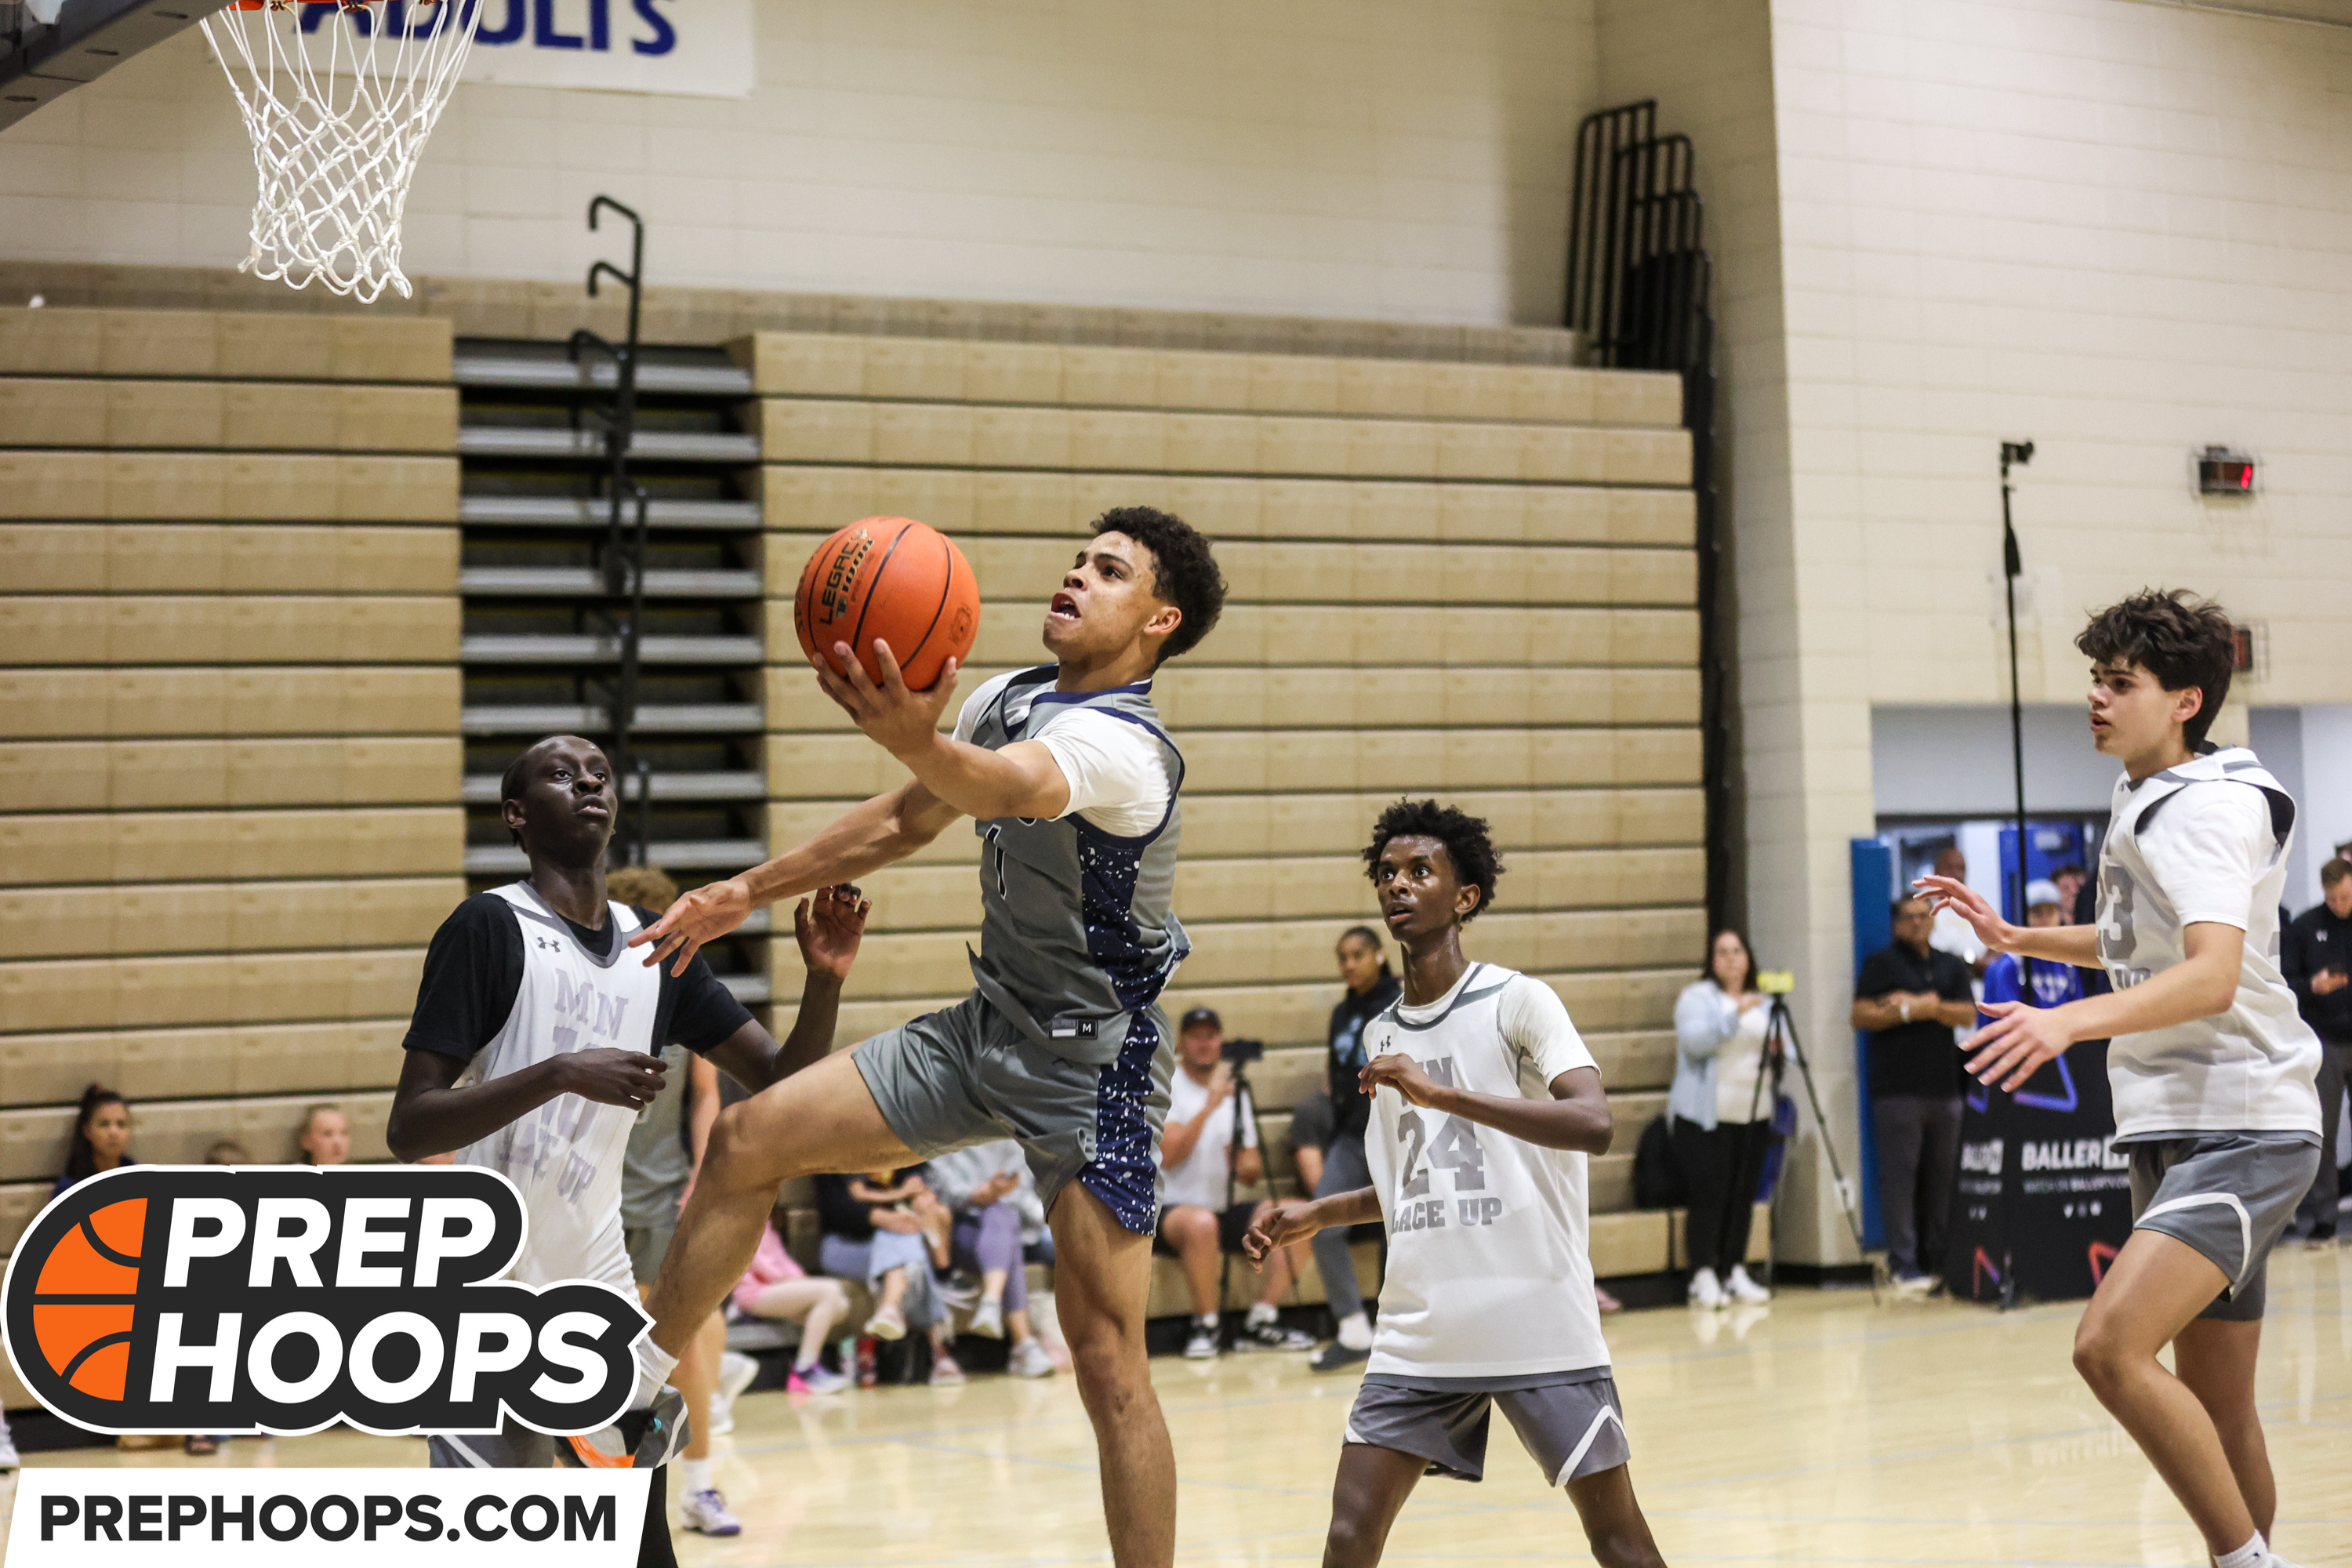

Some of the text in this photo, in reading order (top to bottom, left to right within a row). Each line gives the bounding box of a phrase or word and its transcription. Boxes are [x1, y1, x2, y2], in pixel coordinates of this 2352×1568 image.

[554, 968, 629, 1041] MN
[1082, 1022, 1091, 1033] M
[1398, 1109, 1486, 1201] 24
[1391, 1197, 1503, 1235] LACE UP
